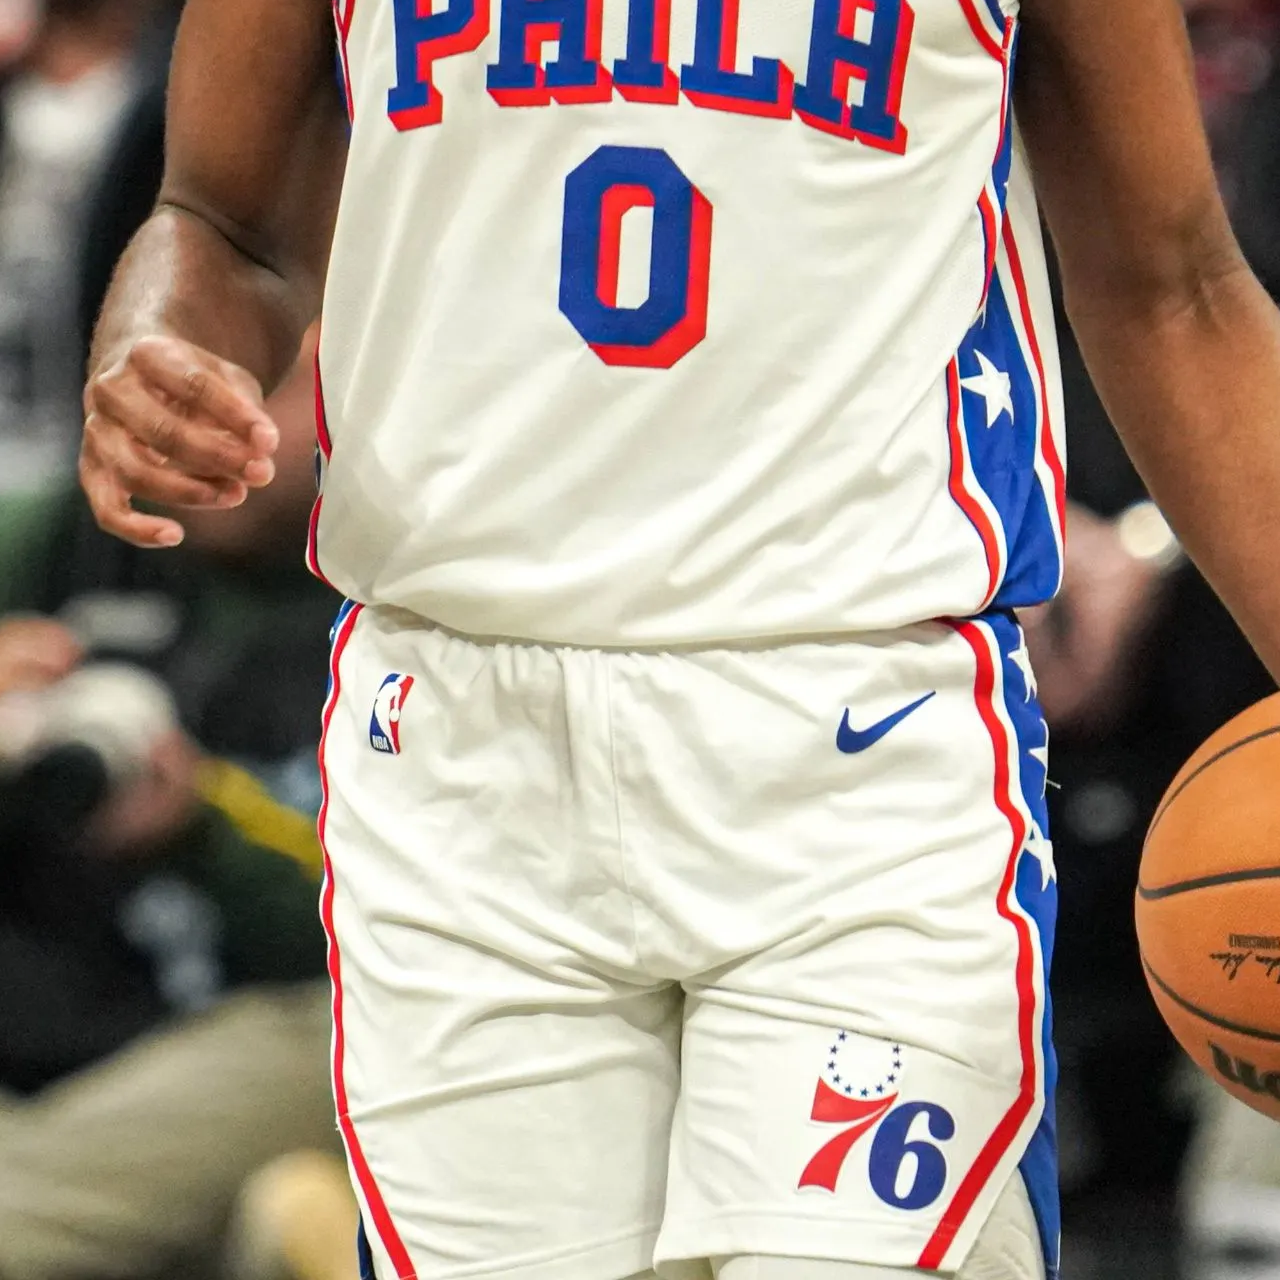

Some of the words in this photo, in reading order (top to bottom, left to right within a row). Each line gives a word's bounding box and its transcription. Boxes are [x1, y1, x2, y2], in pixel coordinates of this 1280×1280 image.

[558, 145, 713, 369] 0
[371, 734, 390, 751] NBA
[798, 1076, 956, 1211] 76
